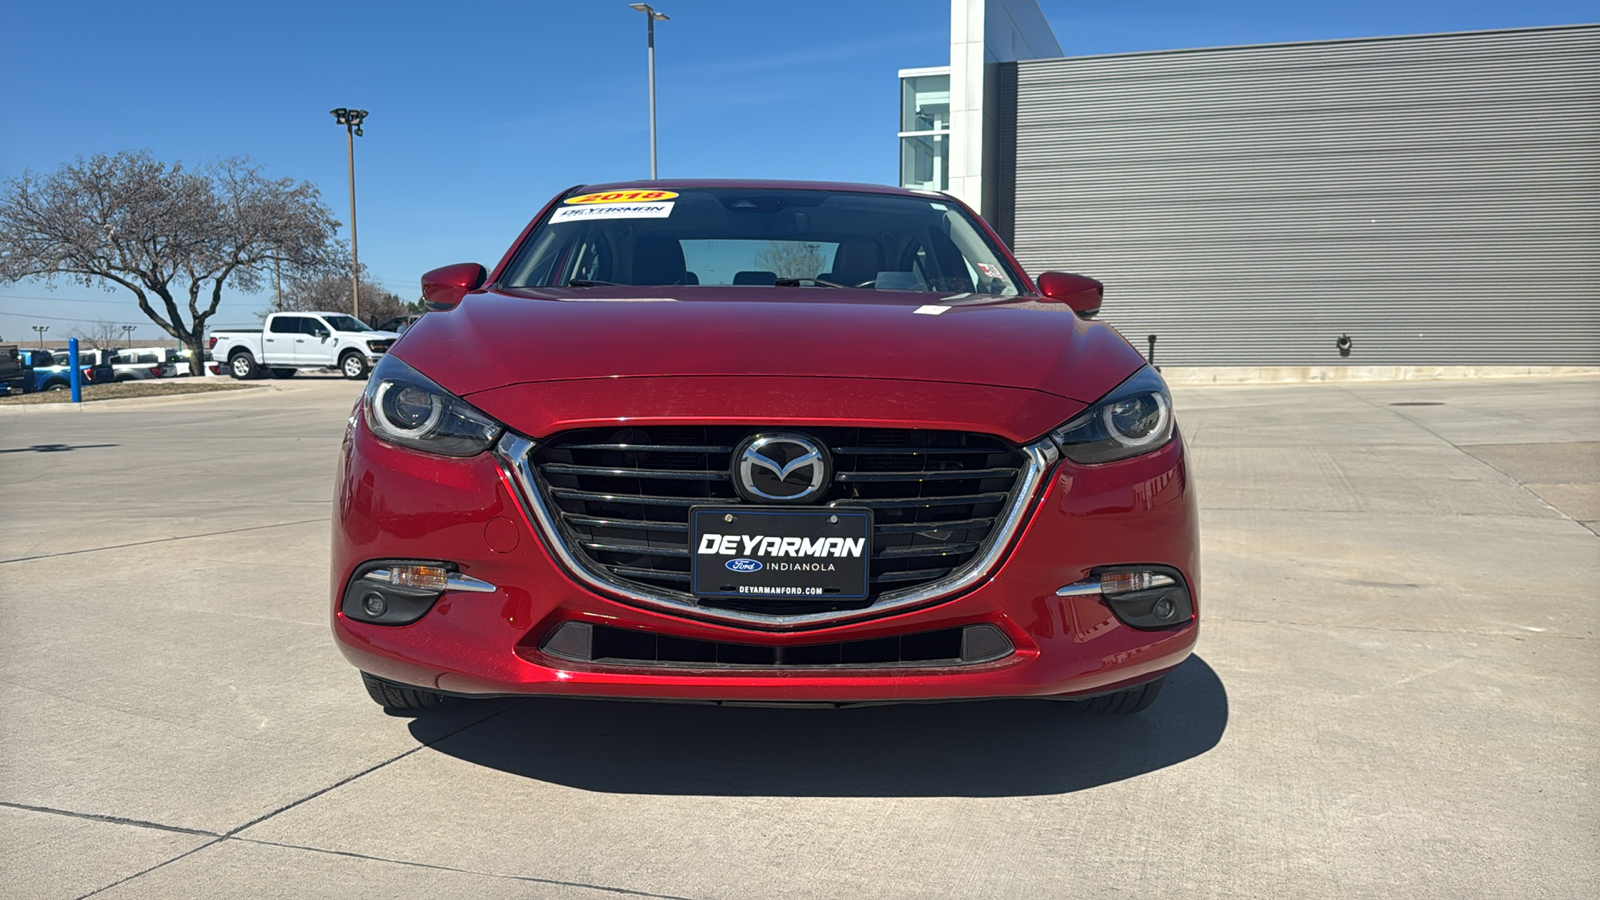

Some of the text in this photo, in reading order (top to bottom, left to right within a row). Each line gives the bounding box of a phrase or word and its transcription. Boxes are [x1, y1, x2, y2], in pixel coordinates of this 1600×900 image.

[577, 191, 665, 203] 2018
[561, 206, 665, 216] DEYARMAN
[698, 534, 866, 558] DEYARMAN
[733, 559, 835, 572] Ford INDIANOLA
[739, 586, 823, 595] DEYARMANFORD.COM
